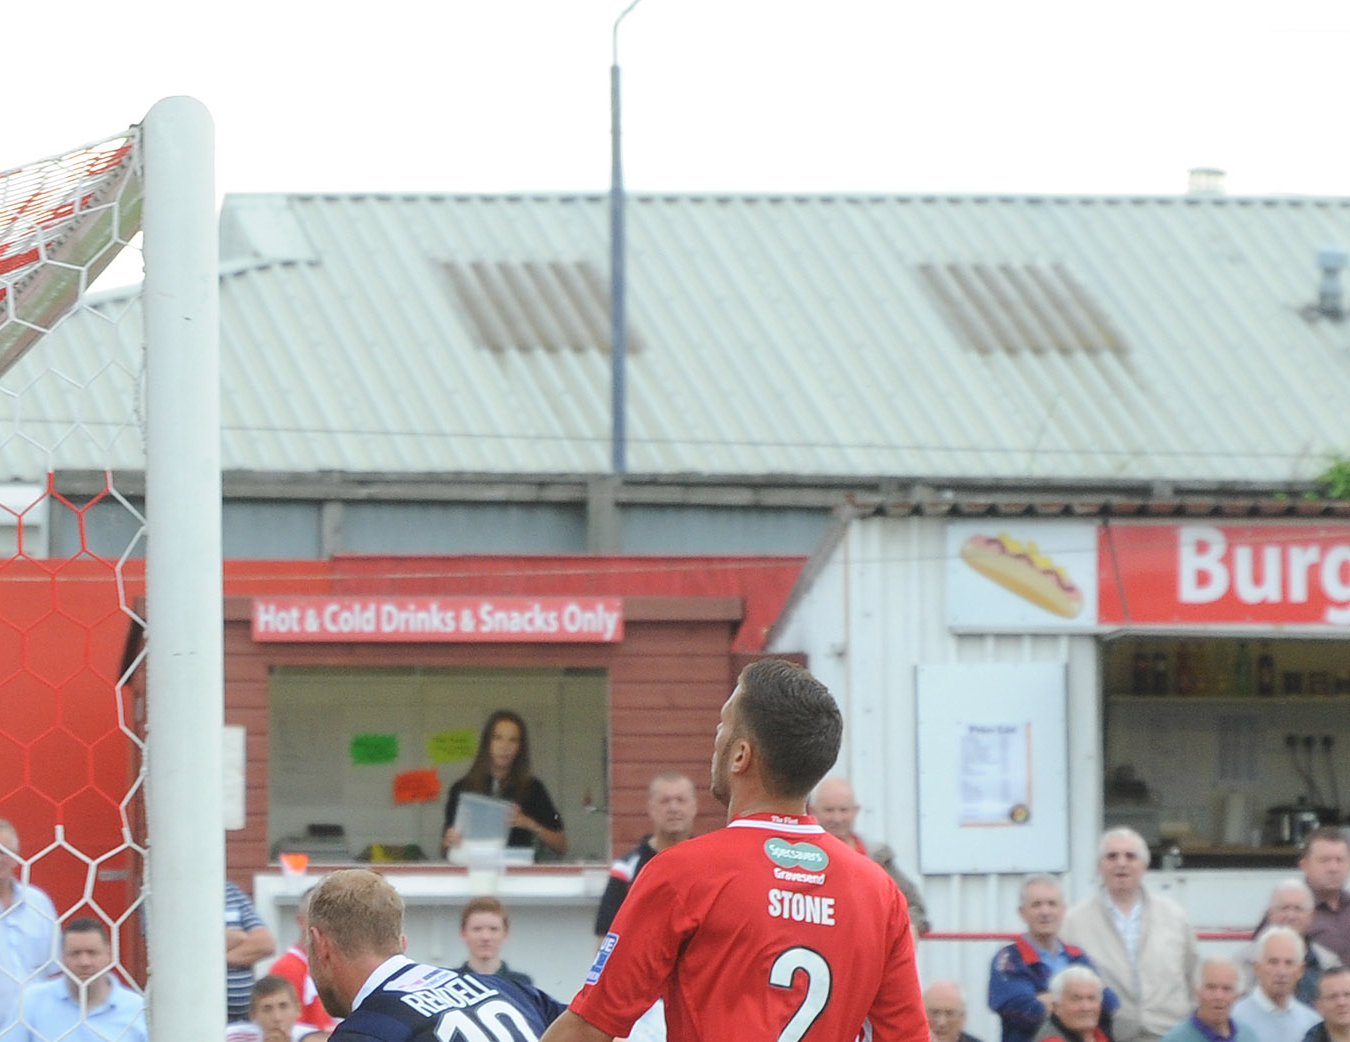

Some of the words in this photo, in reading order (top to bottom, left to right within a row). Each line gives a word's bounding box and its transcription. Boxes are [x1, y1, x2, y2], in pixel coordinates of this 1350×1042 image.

[1178, 525, 1350, 624] Burg
[258, 603, 300, 632] Hot
[305, 608, 319, 632] &
[323, 603, 376, 632] Cold
[381, 603, 455, 632] Drinks
[460, 608, 475, 632] &
[480, 603, 558, 632] Snacks
[564, 603, 618, 640] Only
[769, 844, 822, 862] Specsavers
[774, 867, 825, 885] Gravesend
[768, 888, 835, 925] STONE
[400, 974, 499, 1017] RENDELL
